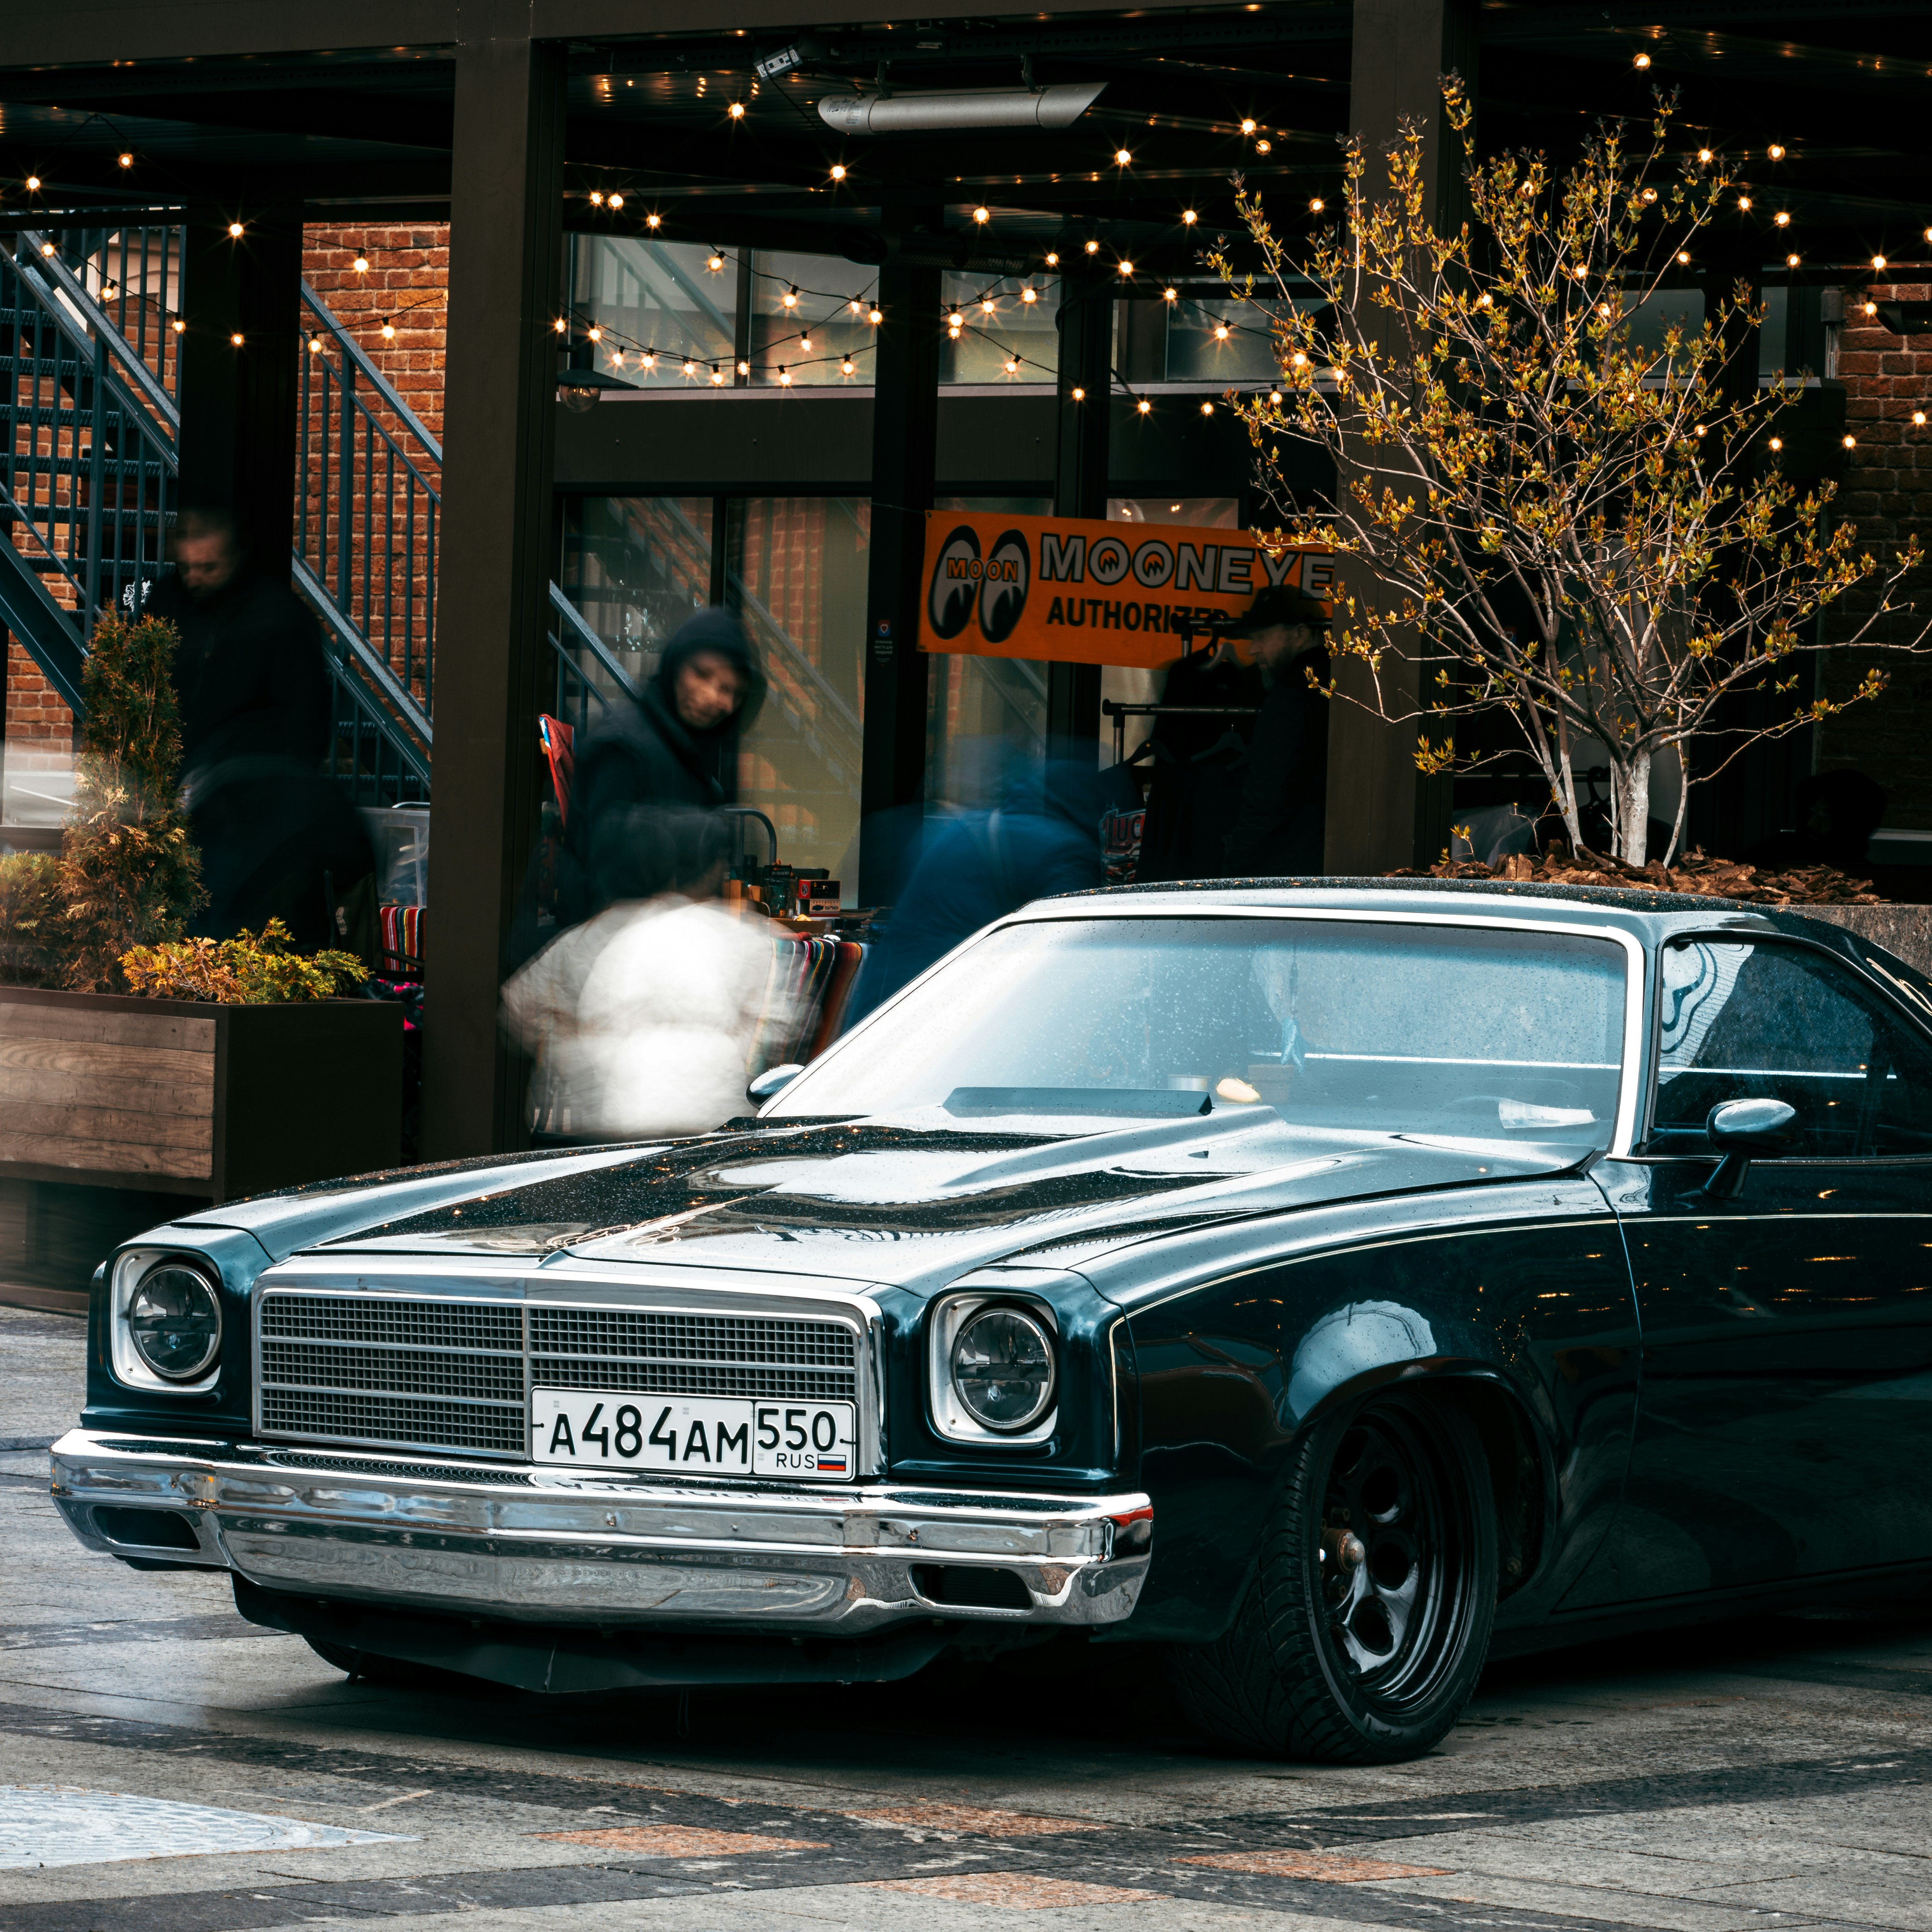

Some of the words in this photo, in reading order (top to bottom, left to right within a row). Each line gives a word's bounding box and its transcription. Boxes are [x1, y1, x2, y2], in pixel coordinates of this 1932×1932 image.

[946, 557, 1019, 583] MOON
[757, 1408, 836, 1452] 550
[776, 1452, 815, 1470] RUS
